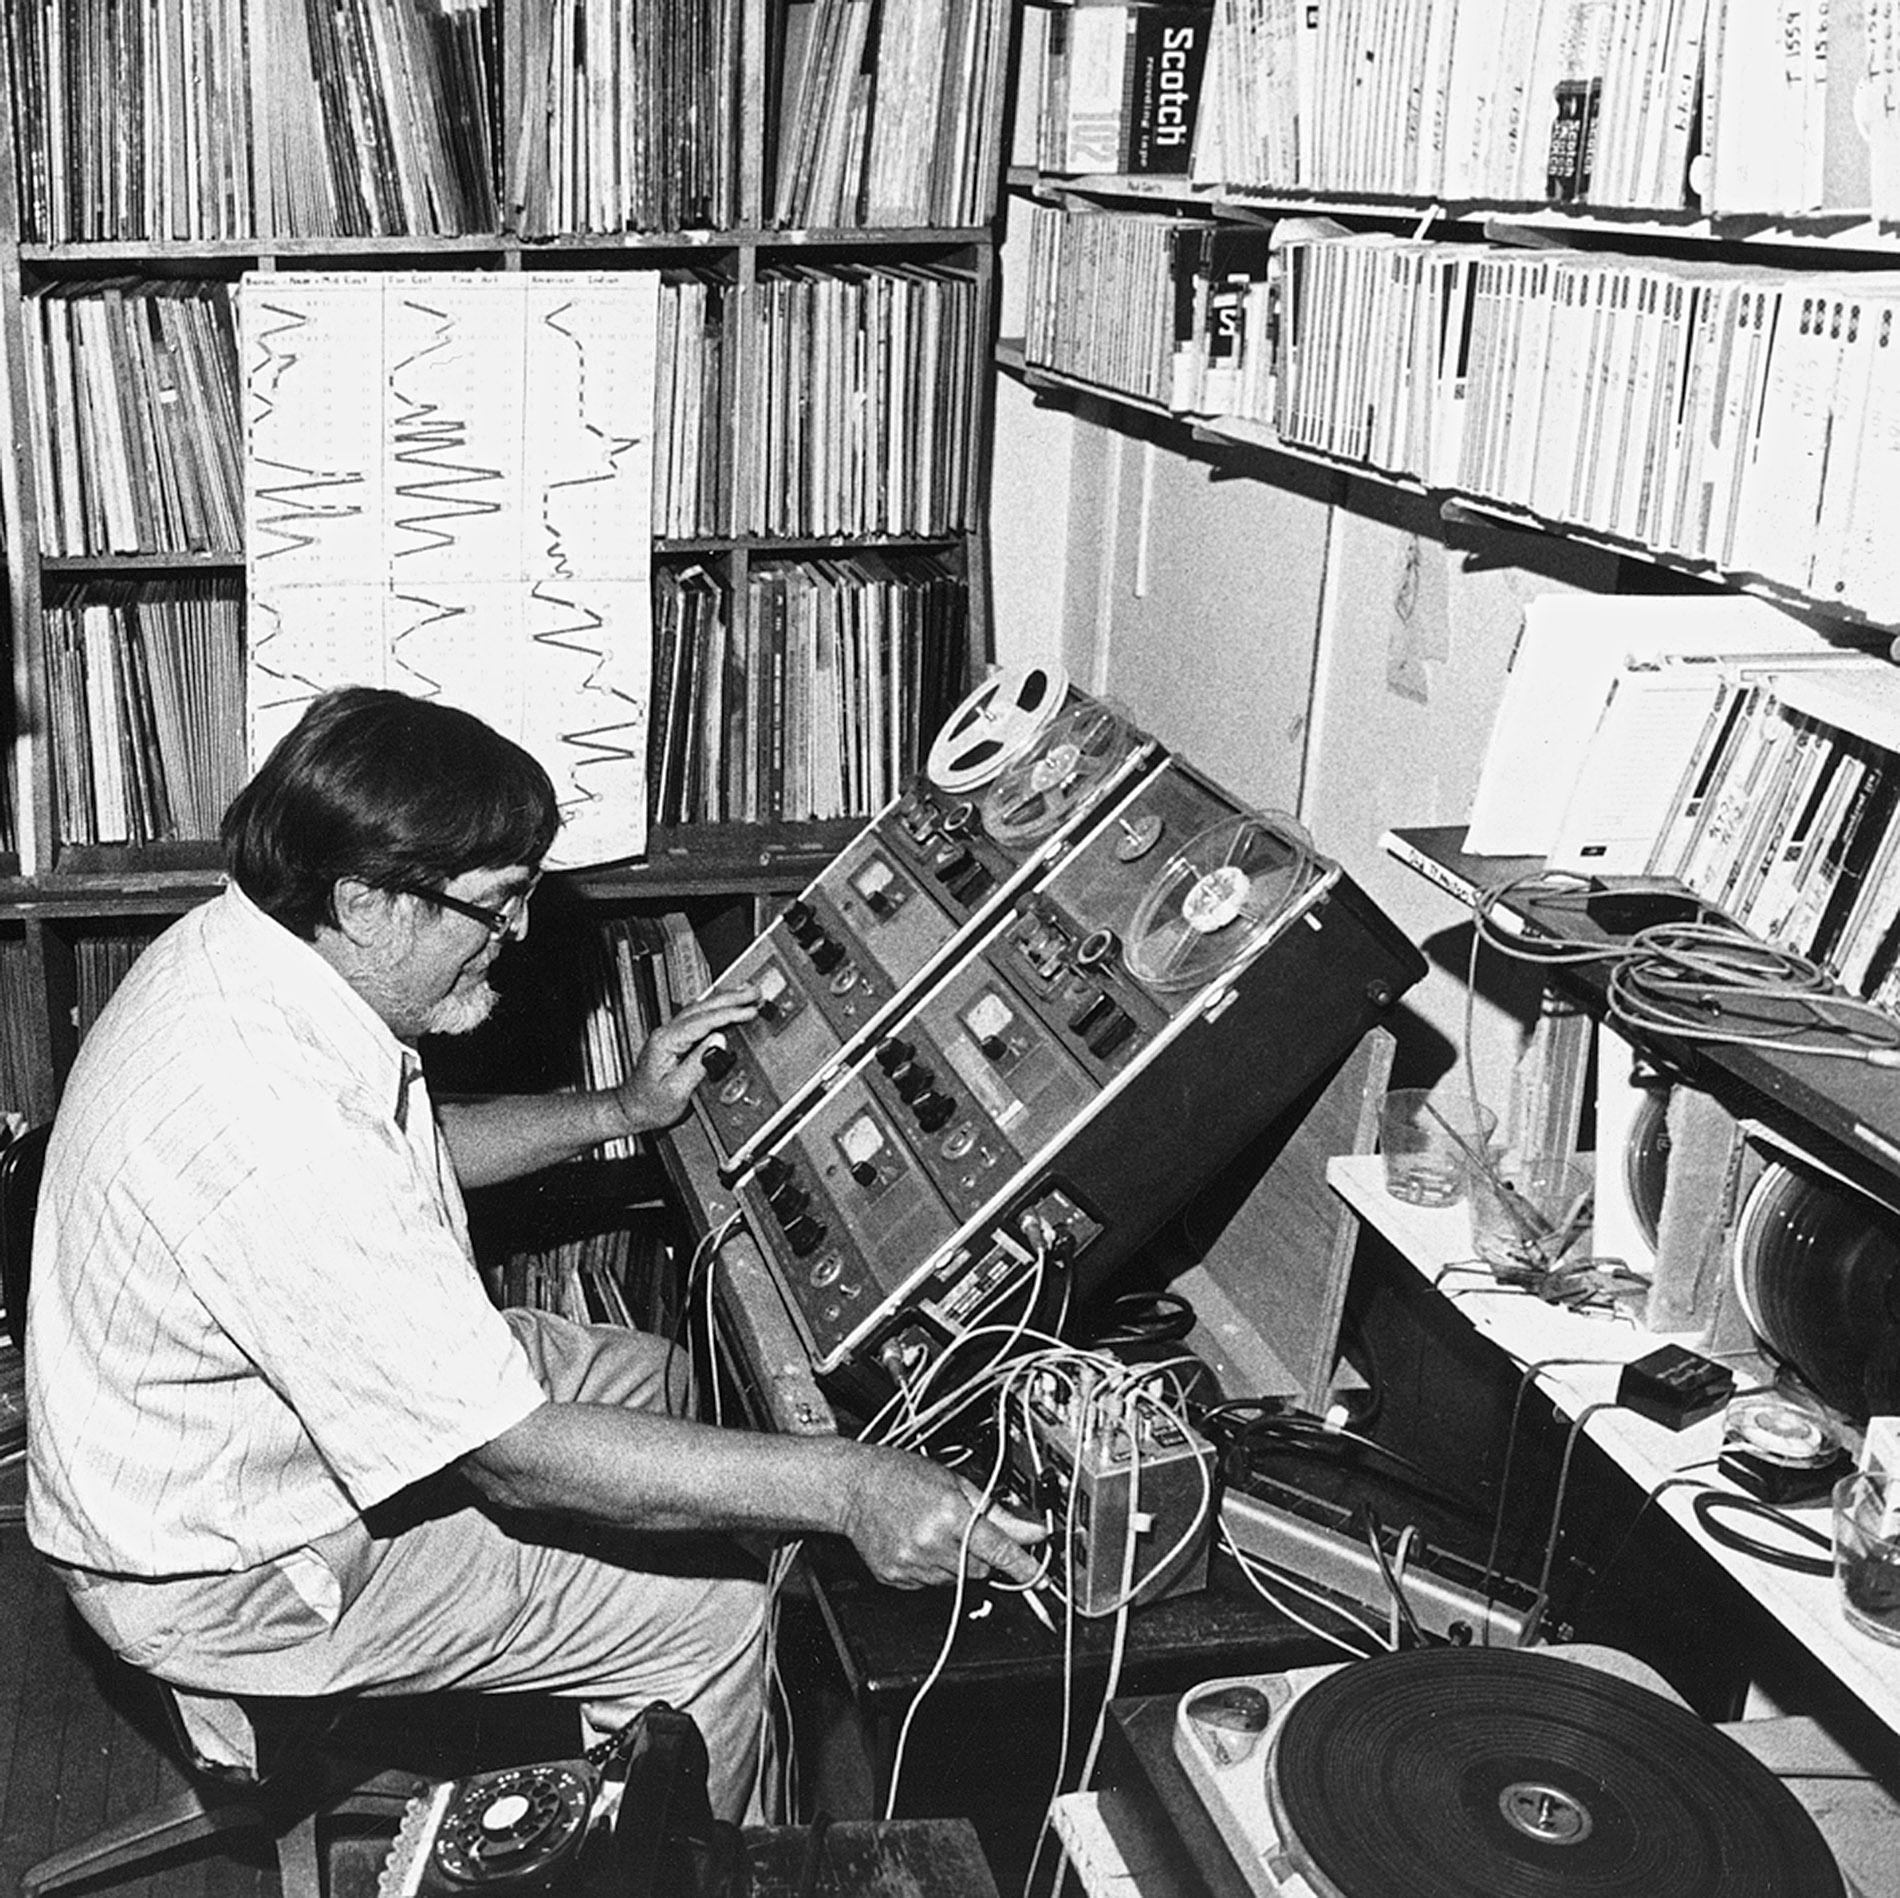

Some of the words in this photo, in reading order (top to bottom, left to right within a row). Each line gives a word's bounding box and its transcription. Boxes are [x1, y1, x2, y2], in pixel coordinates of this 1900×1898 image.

[1785, 12, 1801, 57] 1559
[1141, 56, 1154, 128] recording
[1157, 27, 1194, 145] Scotch
[1786, 70, 1802, 89] T
[1069, 109, 1119, 163] 102
[1139, 134, 1149, 168] tape
[1564, 120, 1581, 177] Scotch
[532, 275, 575, 285] American
[588, 275, 620, 285] Indian
